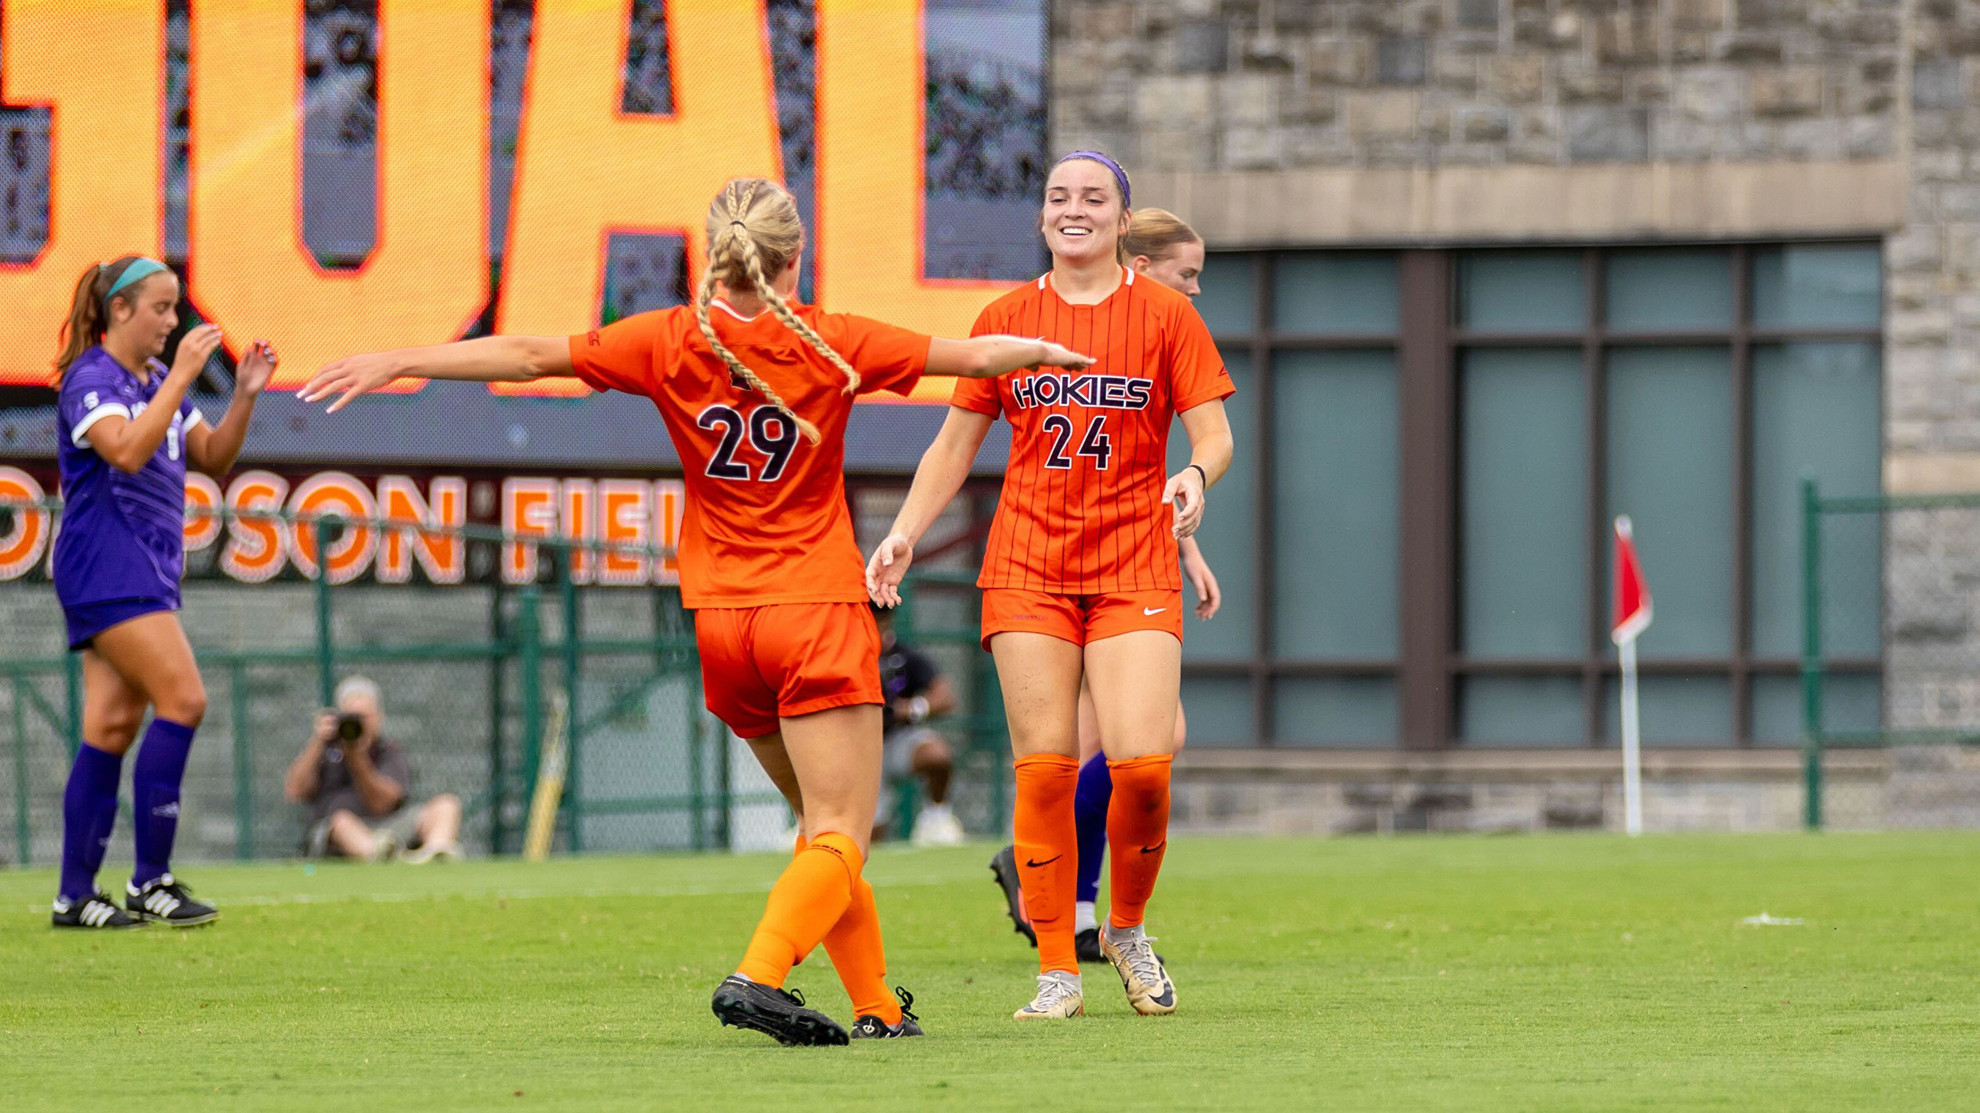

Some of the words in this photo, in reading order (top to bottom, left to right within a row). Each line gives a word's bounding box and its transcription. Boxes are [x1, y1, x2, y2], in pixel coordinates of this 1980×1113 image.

[1012, 373, 1154, 411] HOKIES
[696, 403, 801, 483] 29
[1042, 413, 1113, 471] 24
[0, 465, 468, 584] OPSON
[503, 477, 685, 586] FIEL
